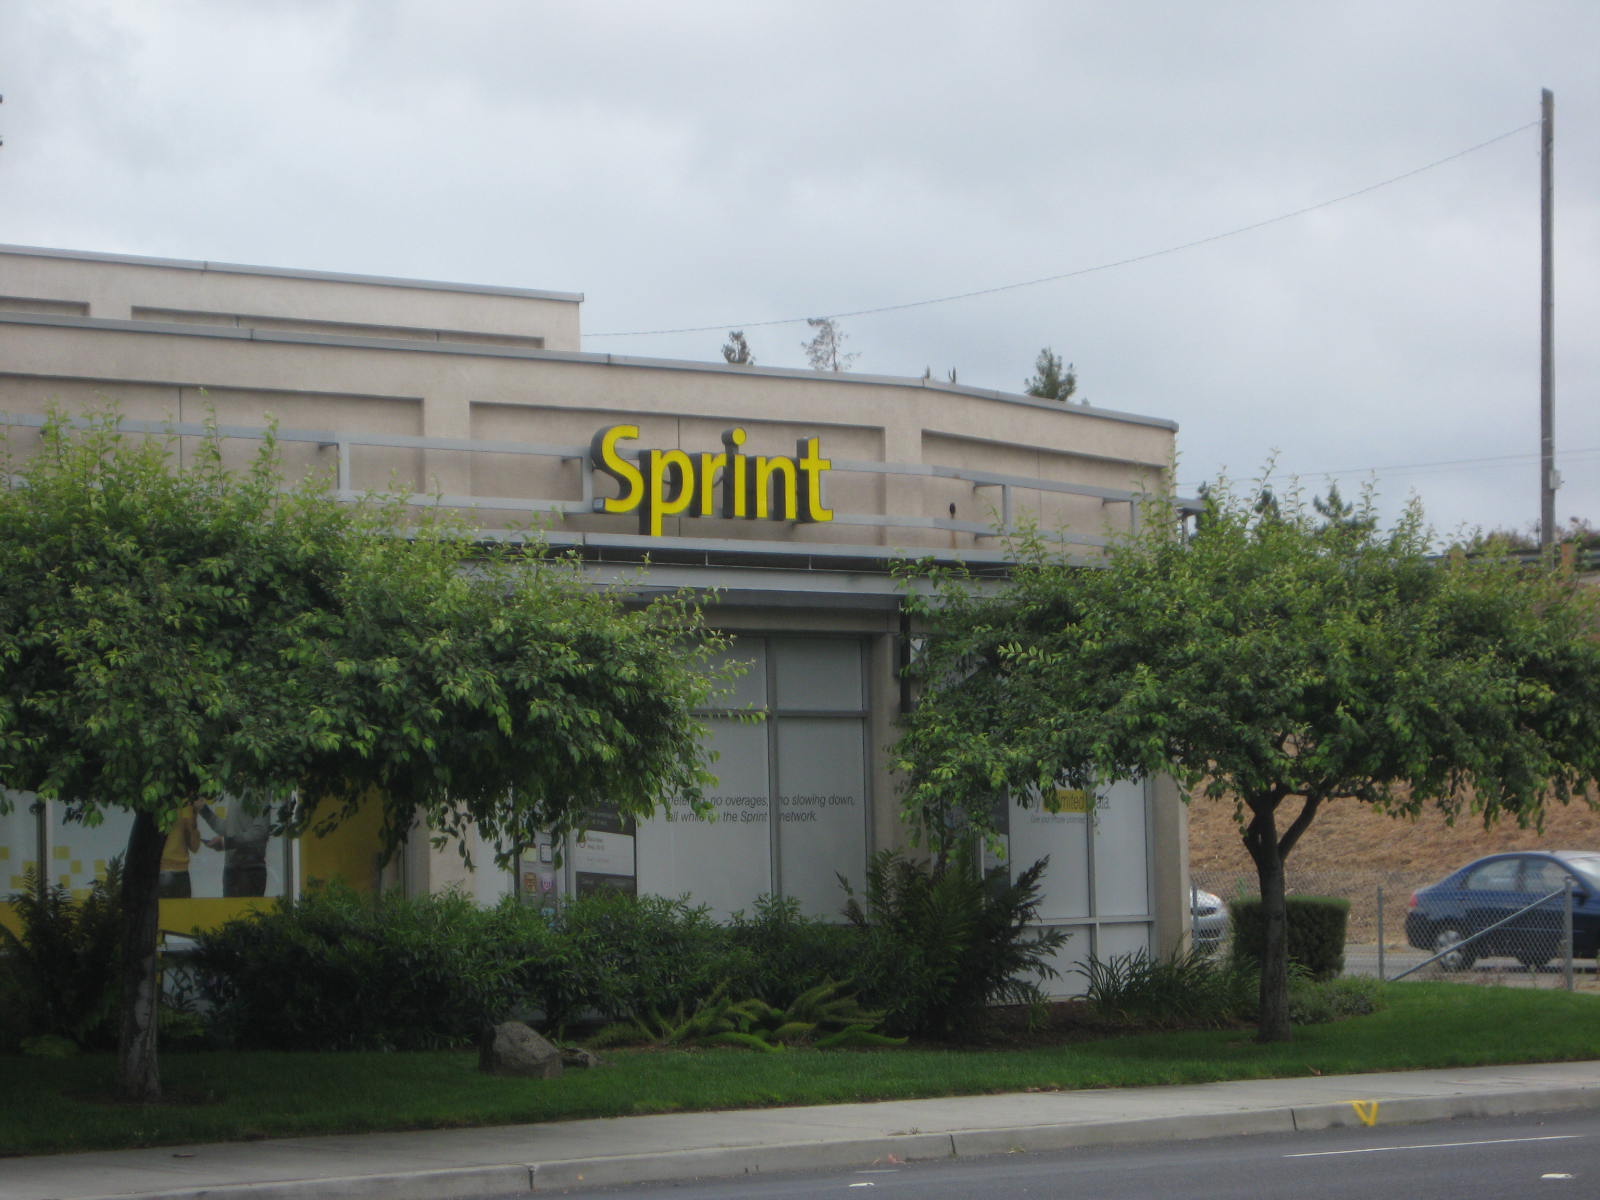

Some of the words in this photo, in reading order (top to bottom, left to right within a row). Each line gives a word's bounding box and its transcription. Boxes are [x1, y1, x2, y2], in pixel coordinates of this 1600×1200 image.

[601, 423, 833, 537] Sprint
[791, 794, 826, 808] slowing
[723, 811, 738, 822] the
[740, 811, 768, 824] Sprint
